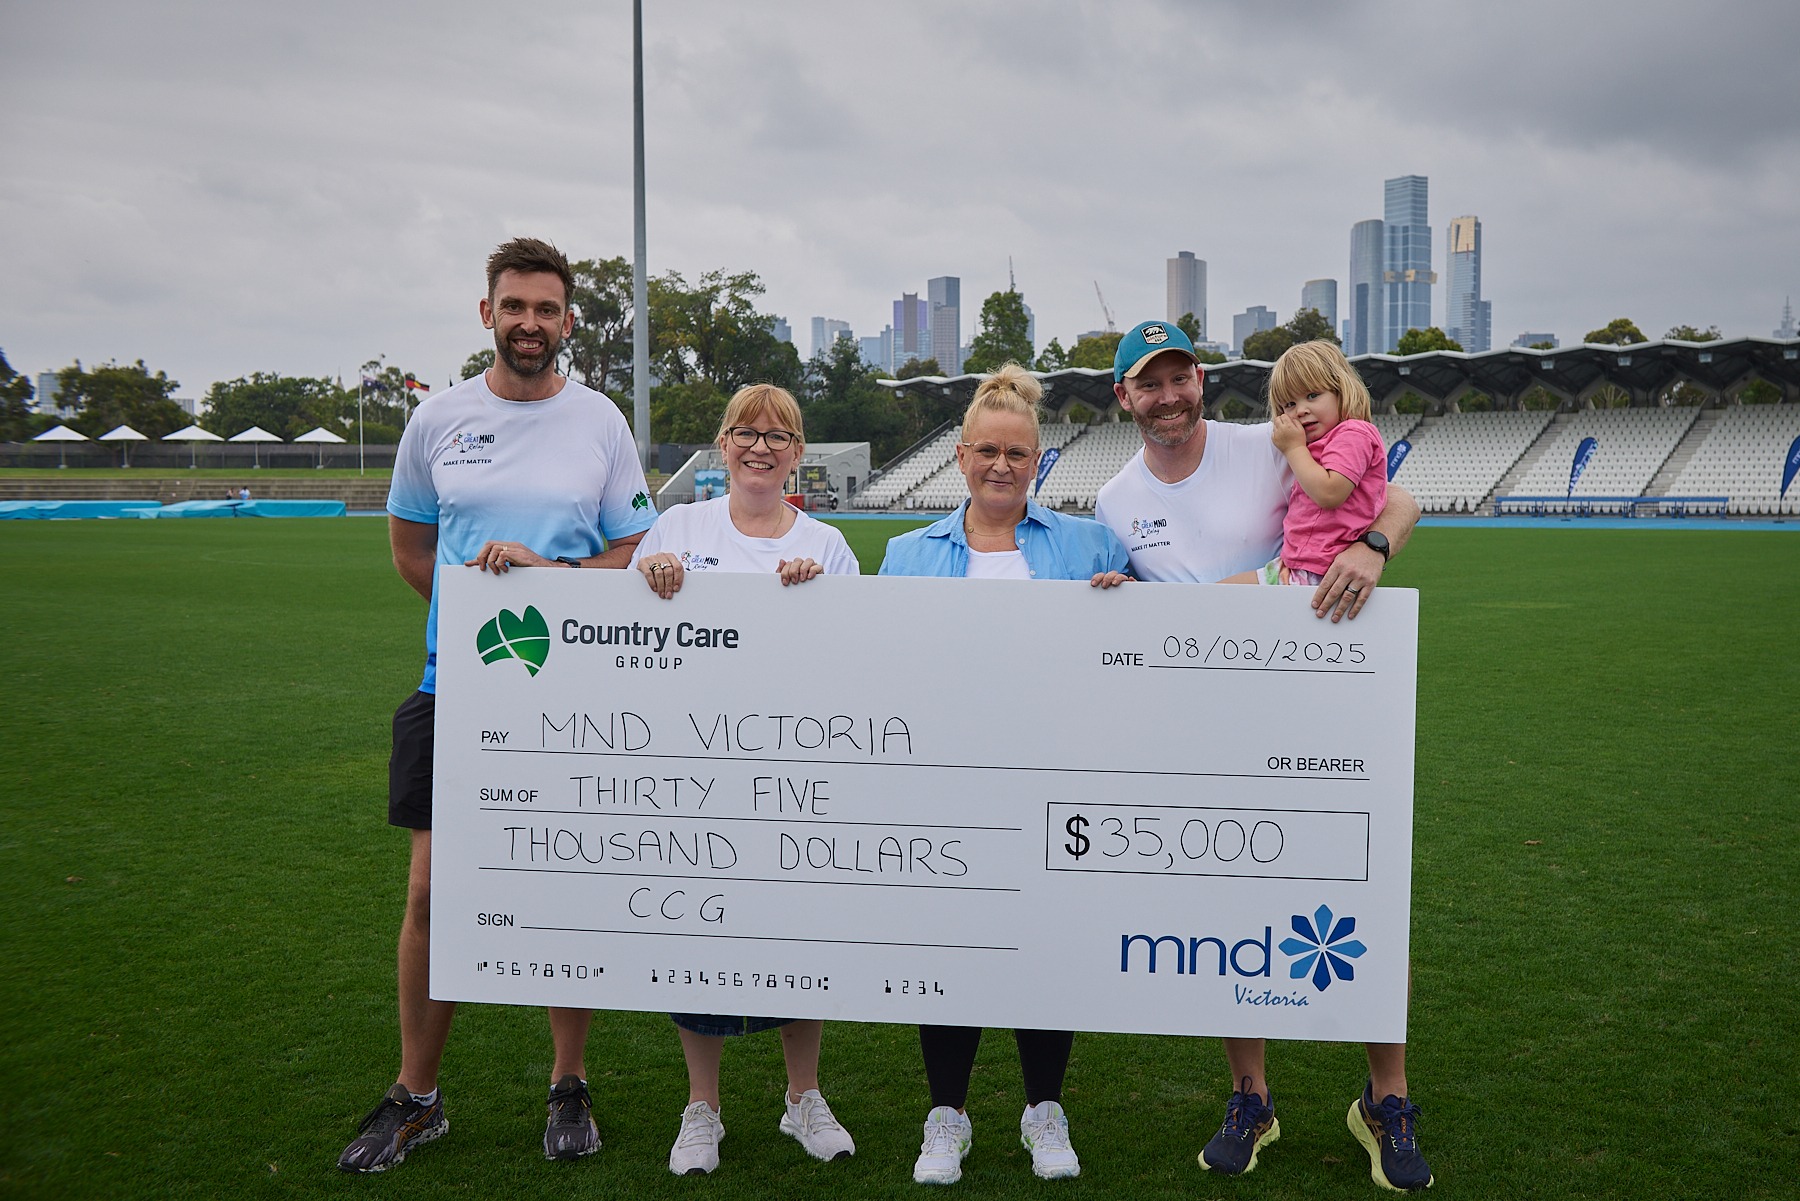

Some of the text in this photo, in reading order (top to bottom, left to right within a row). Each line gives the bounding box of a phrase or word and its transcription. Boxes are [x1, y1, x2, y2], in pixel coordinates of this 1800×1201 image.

[479, 434, 494, 443] MND
[469, 443, 484, 451] Relay
[1153, 518, 1167, 528] MND
[1131, 544, 1143, 552] MAKE
[704, 556, 719, 566] MND
[562, 618, 739, 652] Country Care
[1163, 635, 1367, 667] 08/02/2025
[615, 655, 683, 670] GROUP
[1102, 652, 1144, 667] DATE
[481, 730, 510, 744] PAY
[541, 711, 912, 756] MND VICTORIA
[1267, 756, 1365, 773] OR BEARER
[480, 787, 539, 803] SUM OF
[570, 775, 830, 816] THIRTY FIVE
[1065, 813, 1284, 870] $35,000
[504, 826, 969, 877] THOUSAND DOLLARS
[477, 912, 514, 927] SIGN
[1120, 925, 1272, 978] mnd
[884, 978, 945, 997] 1234
[1234, 983, 1311, 1008] Victoria
